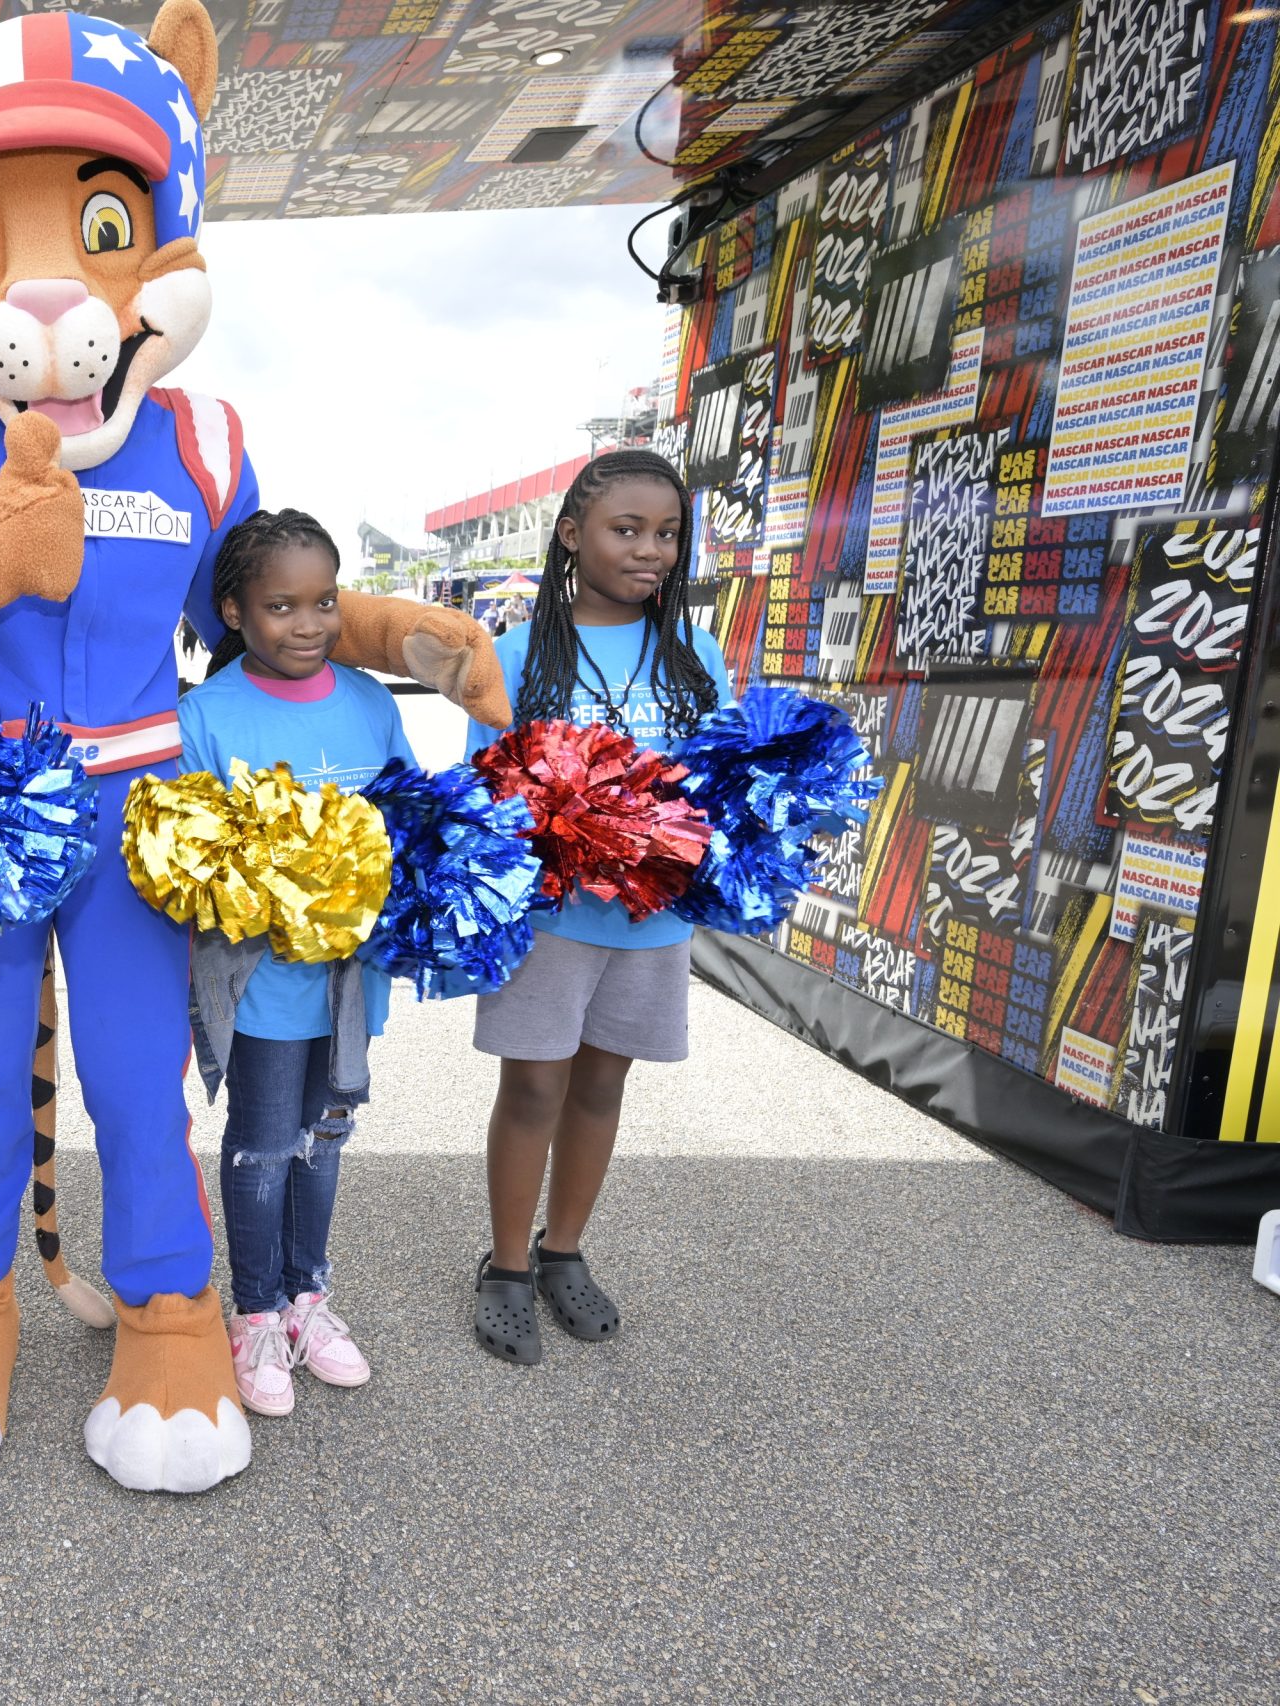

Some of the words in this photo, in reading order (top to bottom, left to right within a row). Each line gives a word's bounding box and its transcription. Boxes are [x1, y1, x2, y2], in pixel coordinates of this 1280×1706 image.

[1065, 30, 1188, 165] NASCAR
[821, 172, 889, 228] 2024
[1079, 224, 1123, 249] NASCAR
[1125, 204, 1173, 232] NASCAR
[1175, 184, 1227, 213] NASCAR
[1078, 238, 1121, 263] NASCAR
[1122, 220, 1170, 247] NASCAR
[1173, 200, 1225, 229] NASCAR
[815, 233, 877, 291] 2024
[1074, 268, 1116, 292] NASCAR
[1118, 252, 1166, 277] NASCAR
[1168, 234, 1219, 261] NASCAR
[1066, 327, 1108, 348] NASCAR
[1110, 314, 1157, 336] NASCAR
[1159, 299, 1209, 323] NASCAR
[1063, 356, 1104, 376] NASCAR
[1106, 344, 1152, 365] NASCAR
[1155, 331, 1204, 353] NASCAR
[1057, 400, 1098, 417] NASCAR
[1100, 389, 1145, 408] NASCAR
[1148, 379, 1197, 398] NASCAR
[1056, 414, 1096, 431] NASCAR
[1098, 405, 1143, 423] NASCAR
[1146, 394, 1194, 414] NASCAR
[1052, 442, 1092, 458] NASCAR
[1094, 434, 1139, 451] NASCAR
[1141, 425, 1190, 443] NASCAR
[1000, 449, 1036, 468] NAS
[998, 465, 1034, 483] CAR
[996, 484, 1032, 502] NAS
[1047, 485, 1086, 499] NASCAR
[1088, 478, 1132, 493] NASCAR
[1135, 472, 1182, 488] NASCAR
[995, 499, 1029, 516] CAR
[1045, 499, 1084, 512] NASCAR
[1086, 493, 1130, 507] NASCAR
[1132, 487, 1180, 502] NASCAR
[908, 480, 990, 553] NASCAR
[992, 517, 1027, 534] NAS
[991, 531, 1025, 549] CAR
[988, 552, 1024, 569] NAS
[1025, 550, 1063, 566] NAS
[1064, 547, 1104, 564] NAS
[987, 566, 1021, 582] CAR
[1024, 564, 1061, 580] CAR
[1062, 561, 1102, 579] CAR
[985, 585, 1019, 602] NAS
[1021, 585, 1058, 601] NAS
[1060, 583, 1100, 601] NAS
[983, 600, 1017, 615] CAR
[1019, 599, 1056, 614] CAR
[1058, 599, 1098, 615] CAR
[896, 597, 975, 657] NASCAR
[932, 825, 1019, 918] 2024
[947, 919, 979, 939] NAS
[946, 933, 977, 954] CAR
[944, 948, 974, 967] NAS
[942, 962, 973, 983] CAR
[976, 960, 1009, 981] NAS
[940, 976, 970, 996] NAS
[975, 976, 1008, 997] CAR
[939, 990, 969, 1011] CAR
